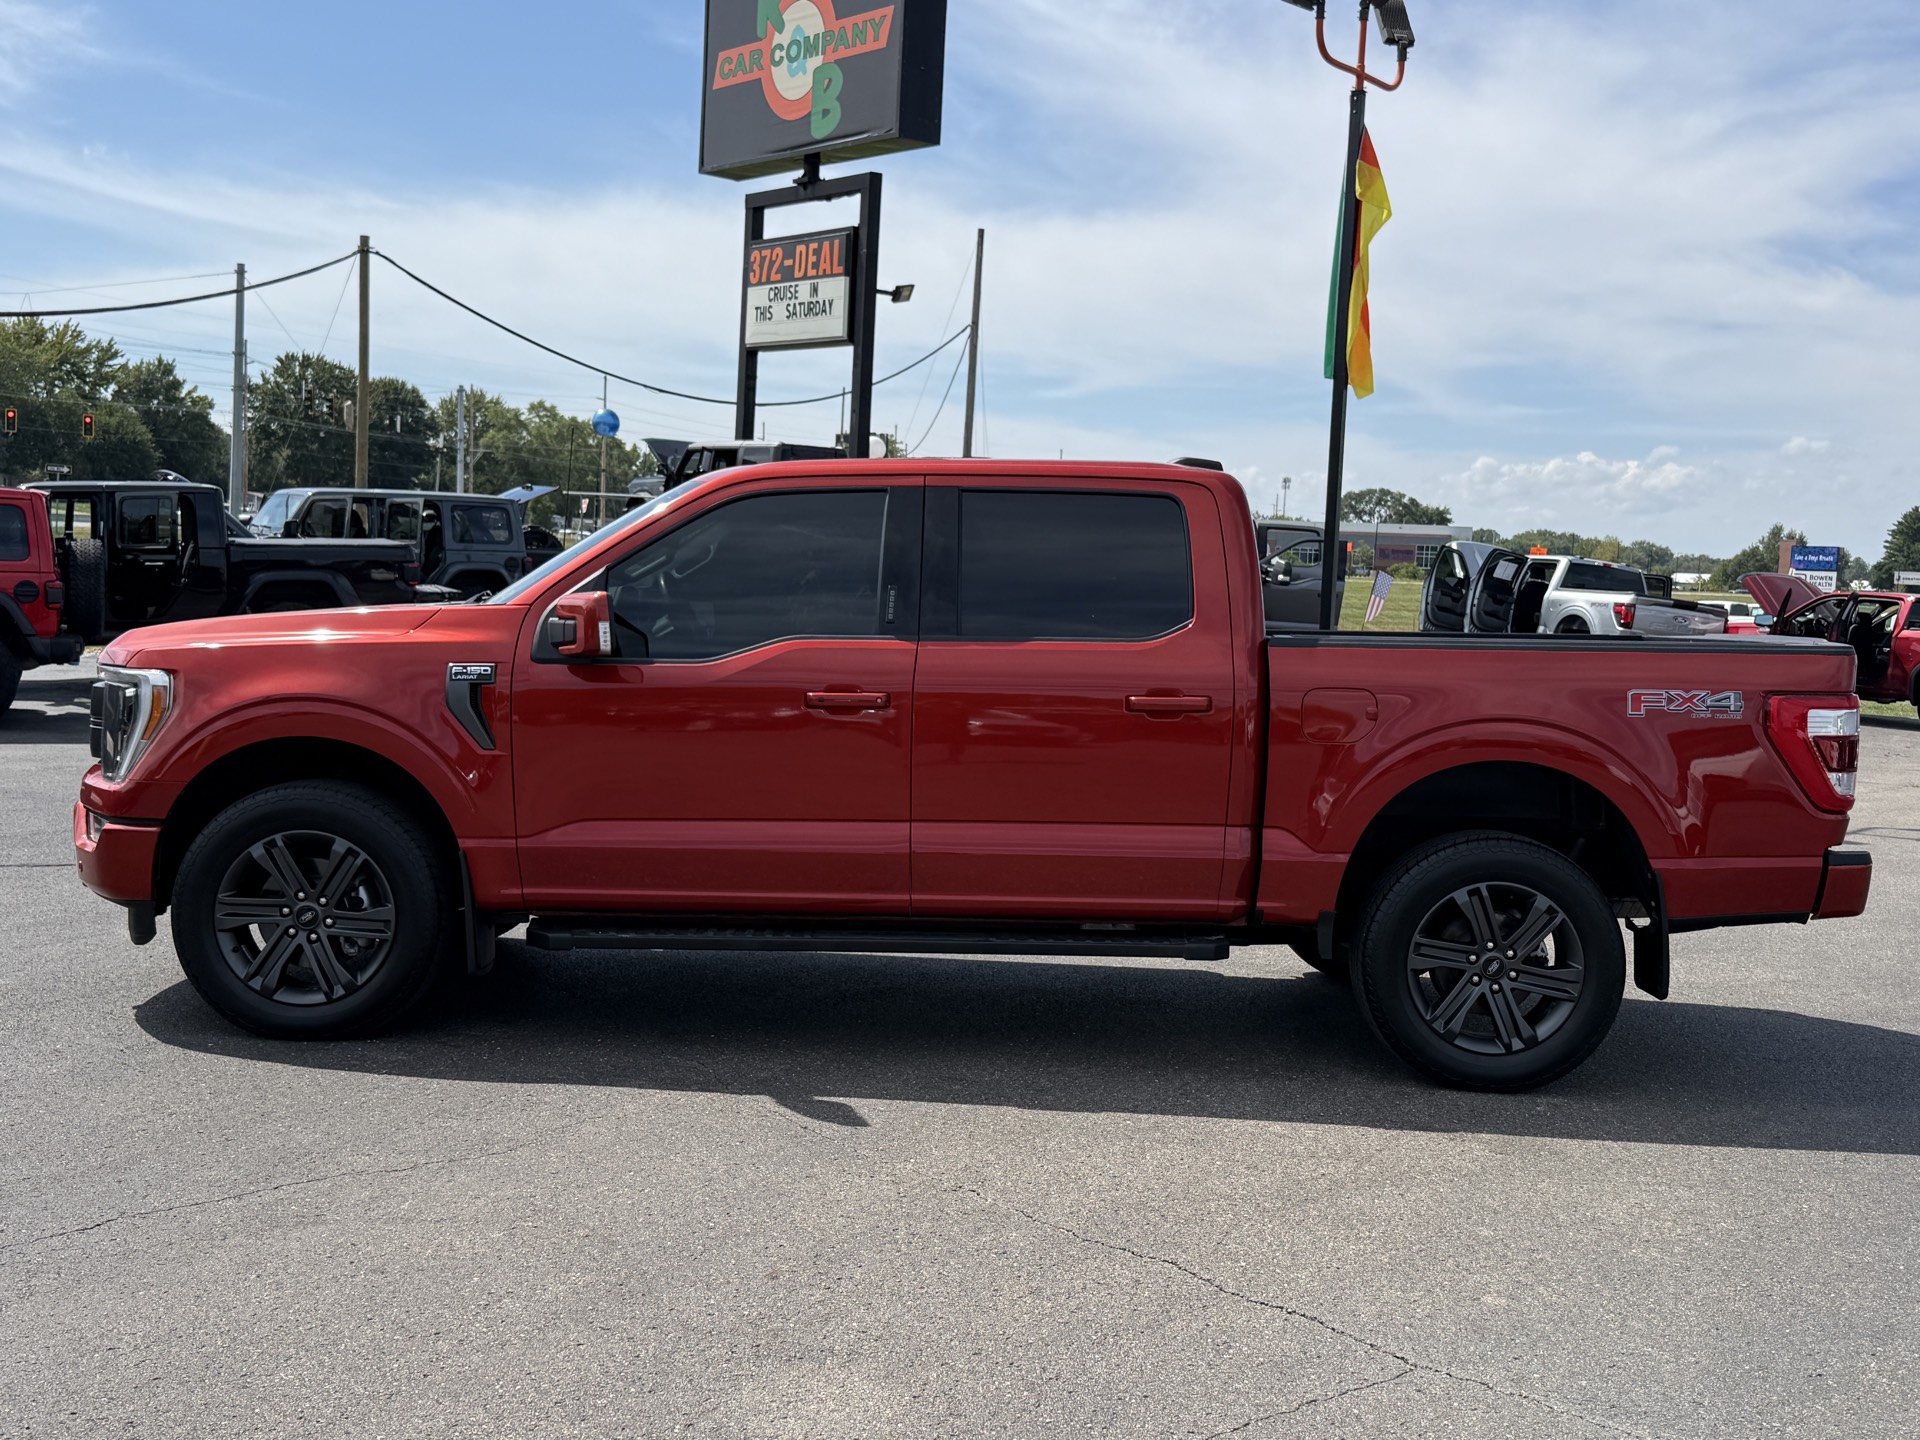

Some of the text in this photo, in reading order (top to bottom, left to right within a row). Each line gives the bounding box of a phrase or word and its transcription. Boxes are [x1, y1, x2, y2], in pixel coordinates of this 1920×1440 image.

[719, 16, 886, 80] CAR COMPANY
[811, 62, 843, 139] B
[749, 239, 843, 284] 372-DEAL
[768, 282, 818, 302] CRUISE IN
[755, 299, 834, 322] THIS SATURDAY
[1627, 689, 1744, 717] FX4
